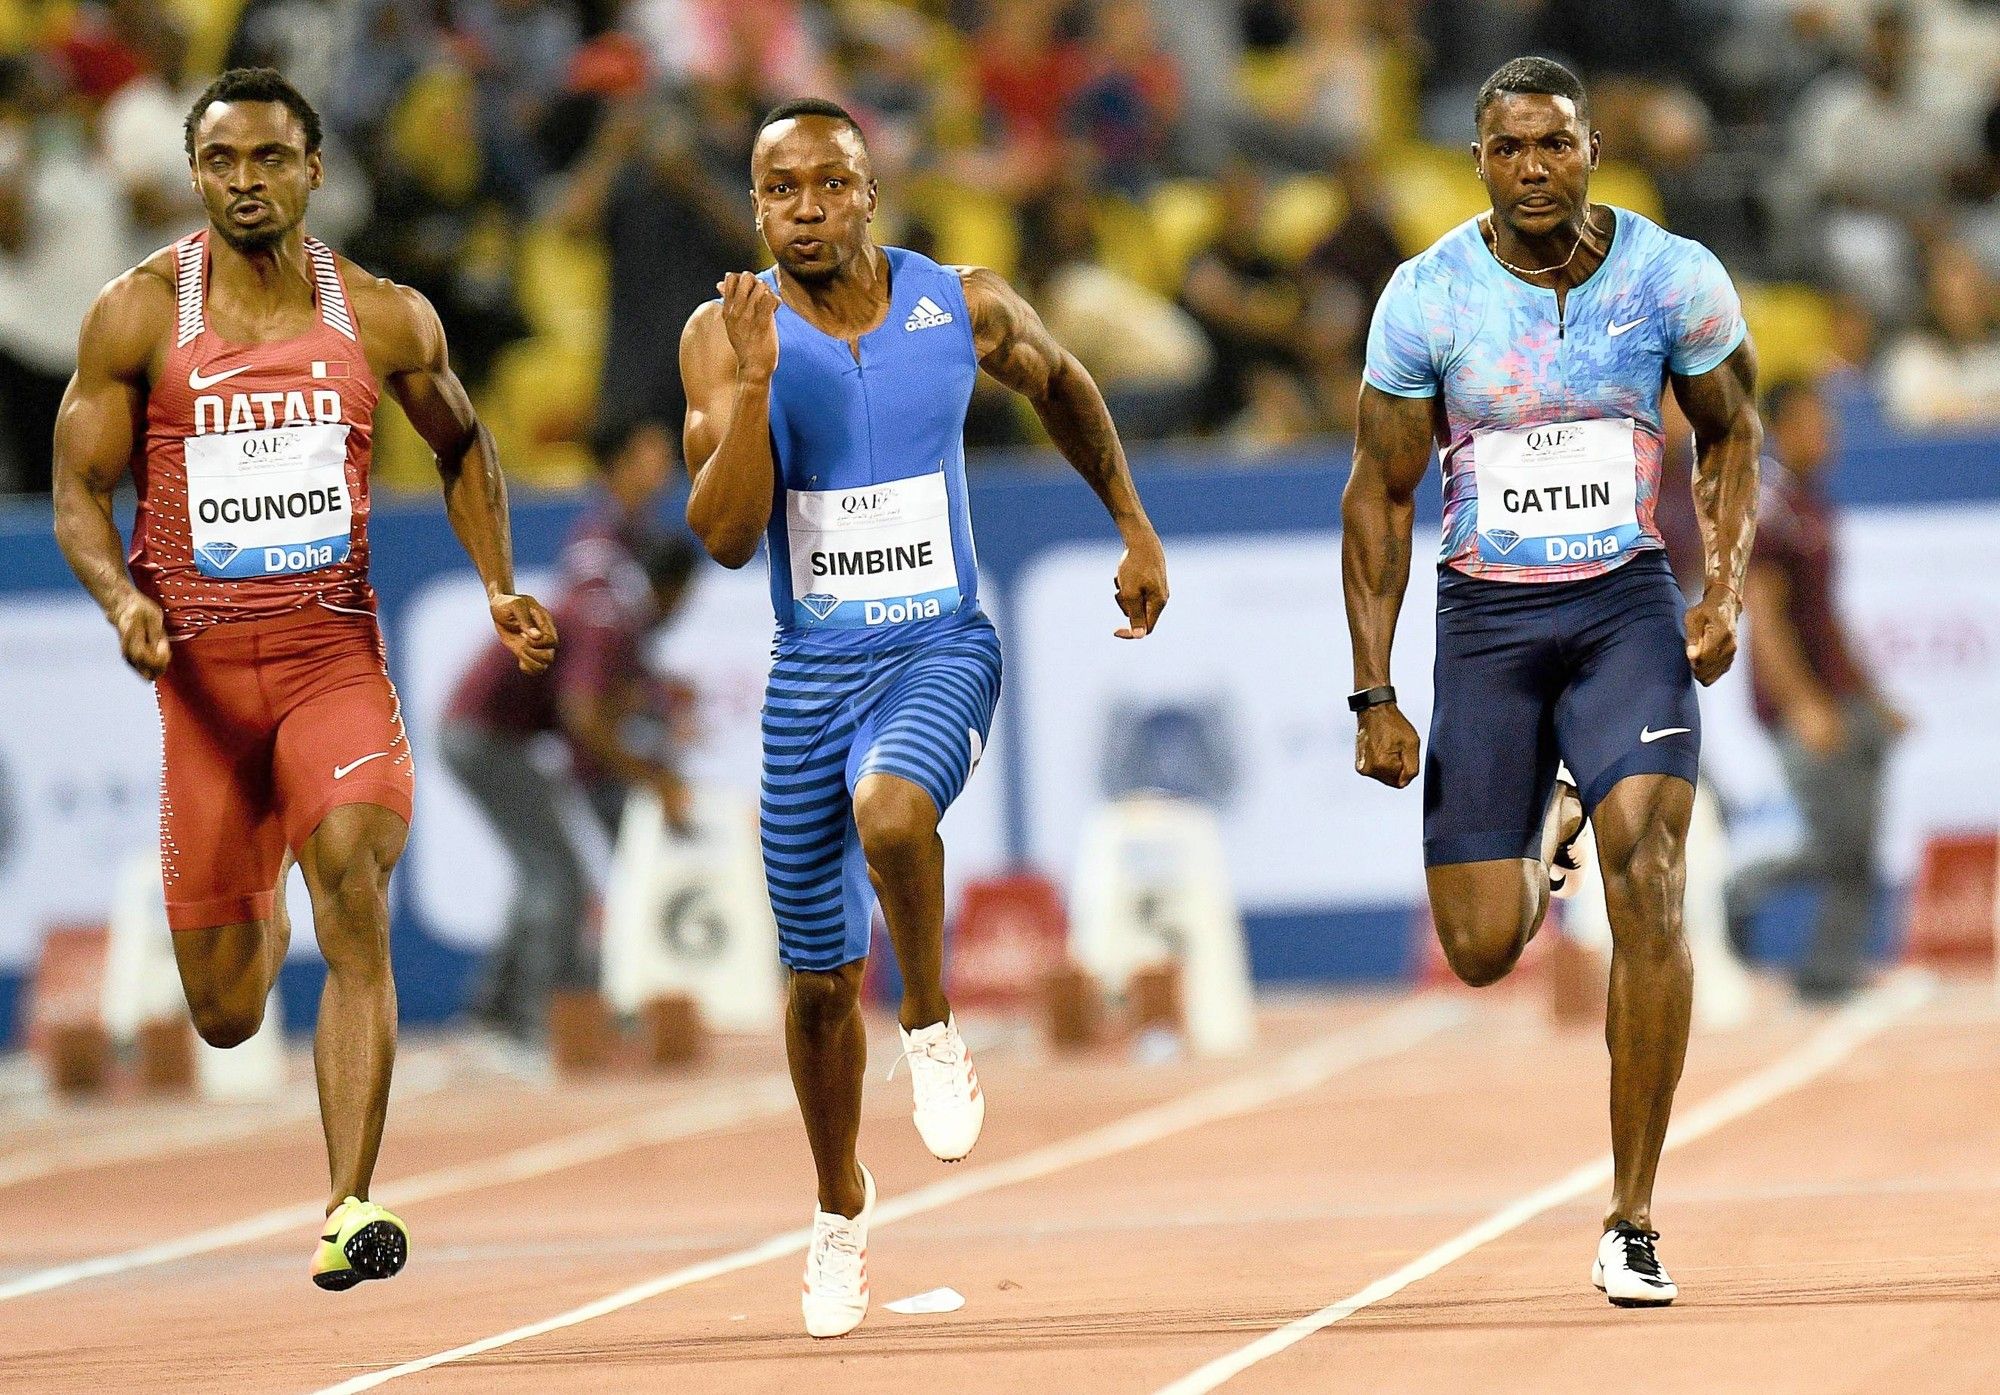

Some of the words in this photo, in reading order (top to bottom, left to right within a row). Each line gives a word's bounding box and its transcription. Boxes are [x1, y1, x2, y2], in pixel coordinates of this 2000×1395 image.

[904, 312, 953, 332] adidas
[199, 486, 341, 523] OGUNODE
[1503, 481, 1610, 513] GATLIN
[264, 544, 333, 572] Doha
[811, 540, 933, 576] SIMBINE
[1545, 534, 1619, 562] Doha
[864, 597, 940, 626] Doha
